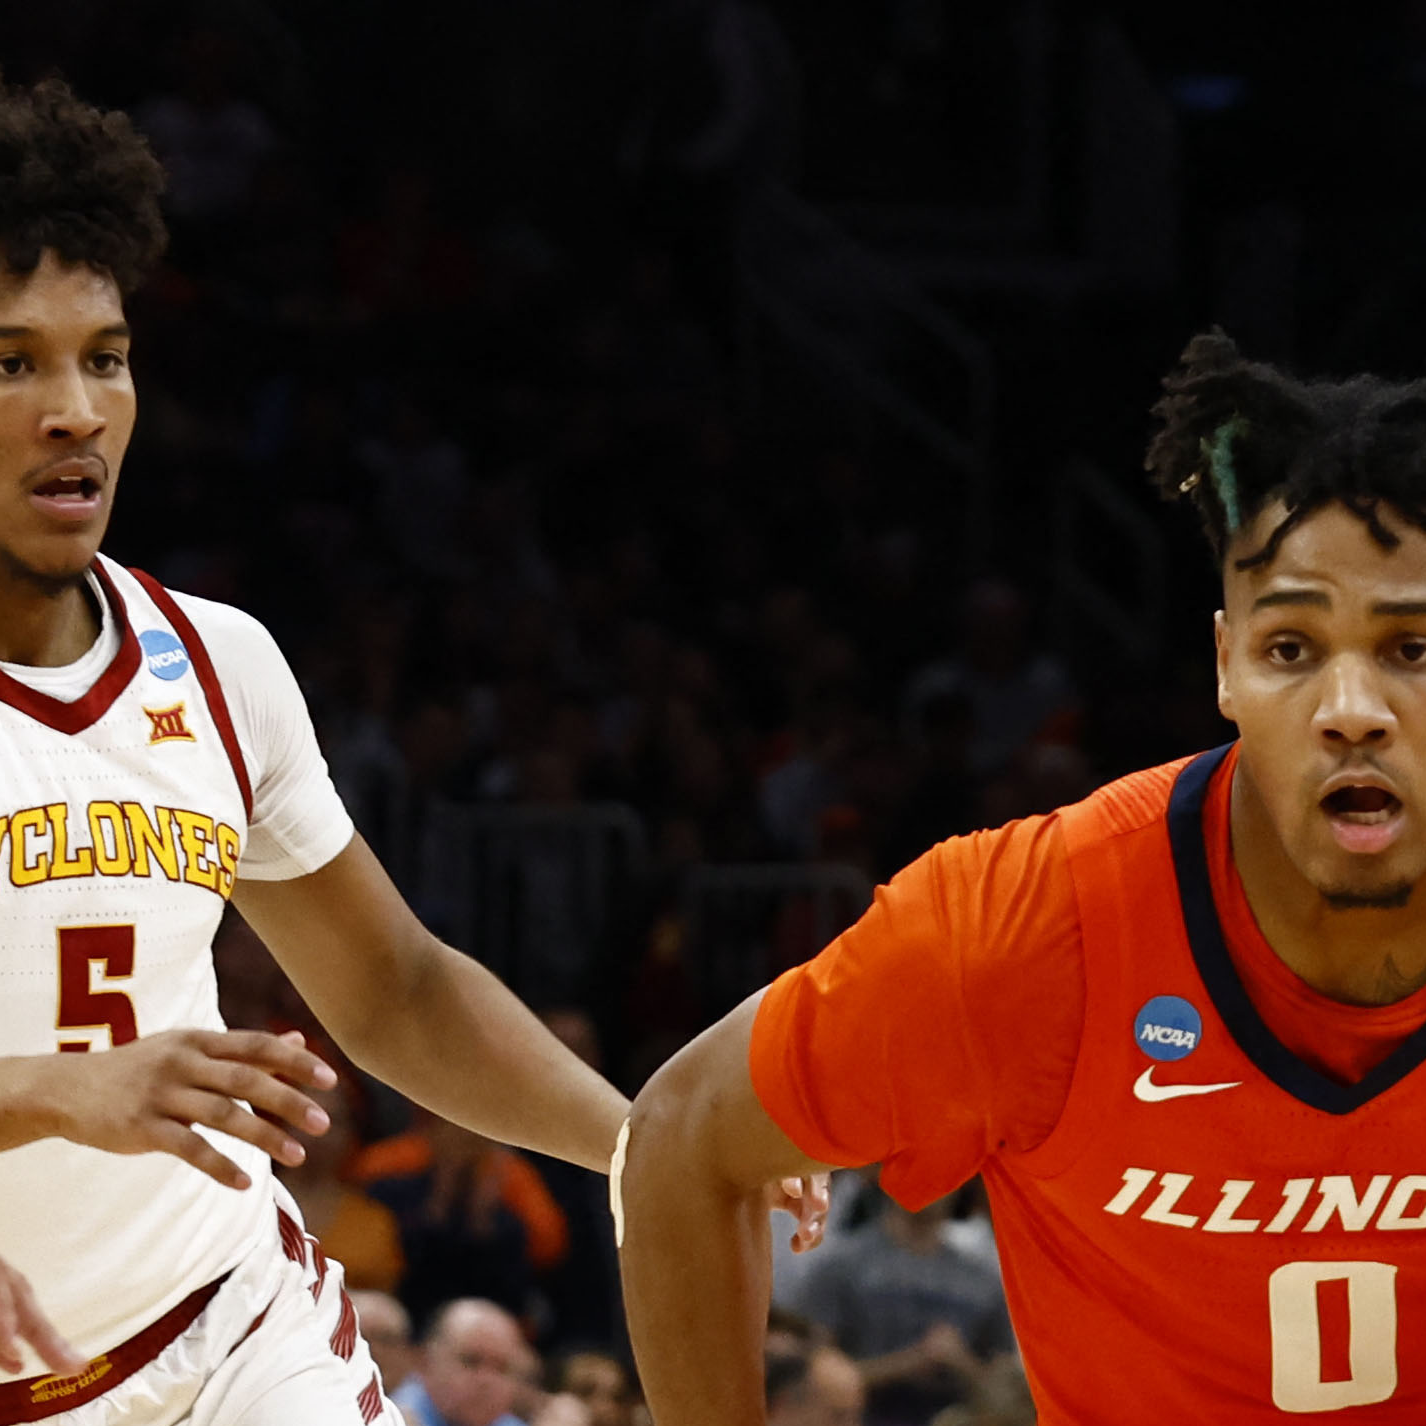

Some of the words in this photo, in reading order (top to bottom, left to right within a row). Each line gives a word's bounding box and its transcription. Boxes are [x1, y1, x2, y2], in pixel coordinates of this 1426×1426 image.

[148, 648, 188, 669] NCAA
[55, 923, 140, 1053] 5
[1140, 1023, 1196, 1050] NCAA
[1269, 1261, 1398, 1413] 0
